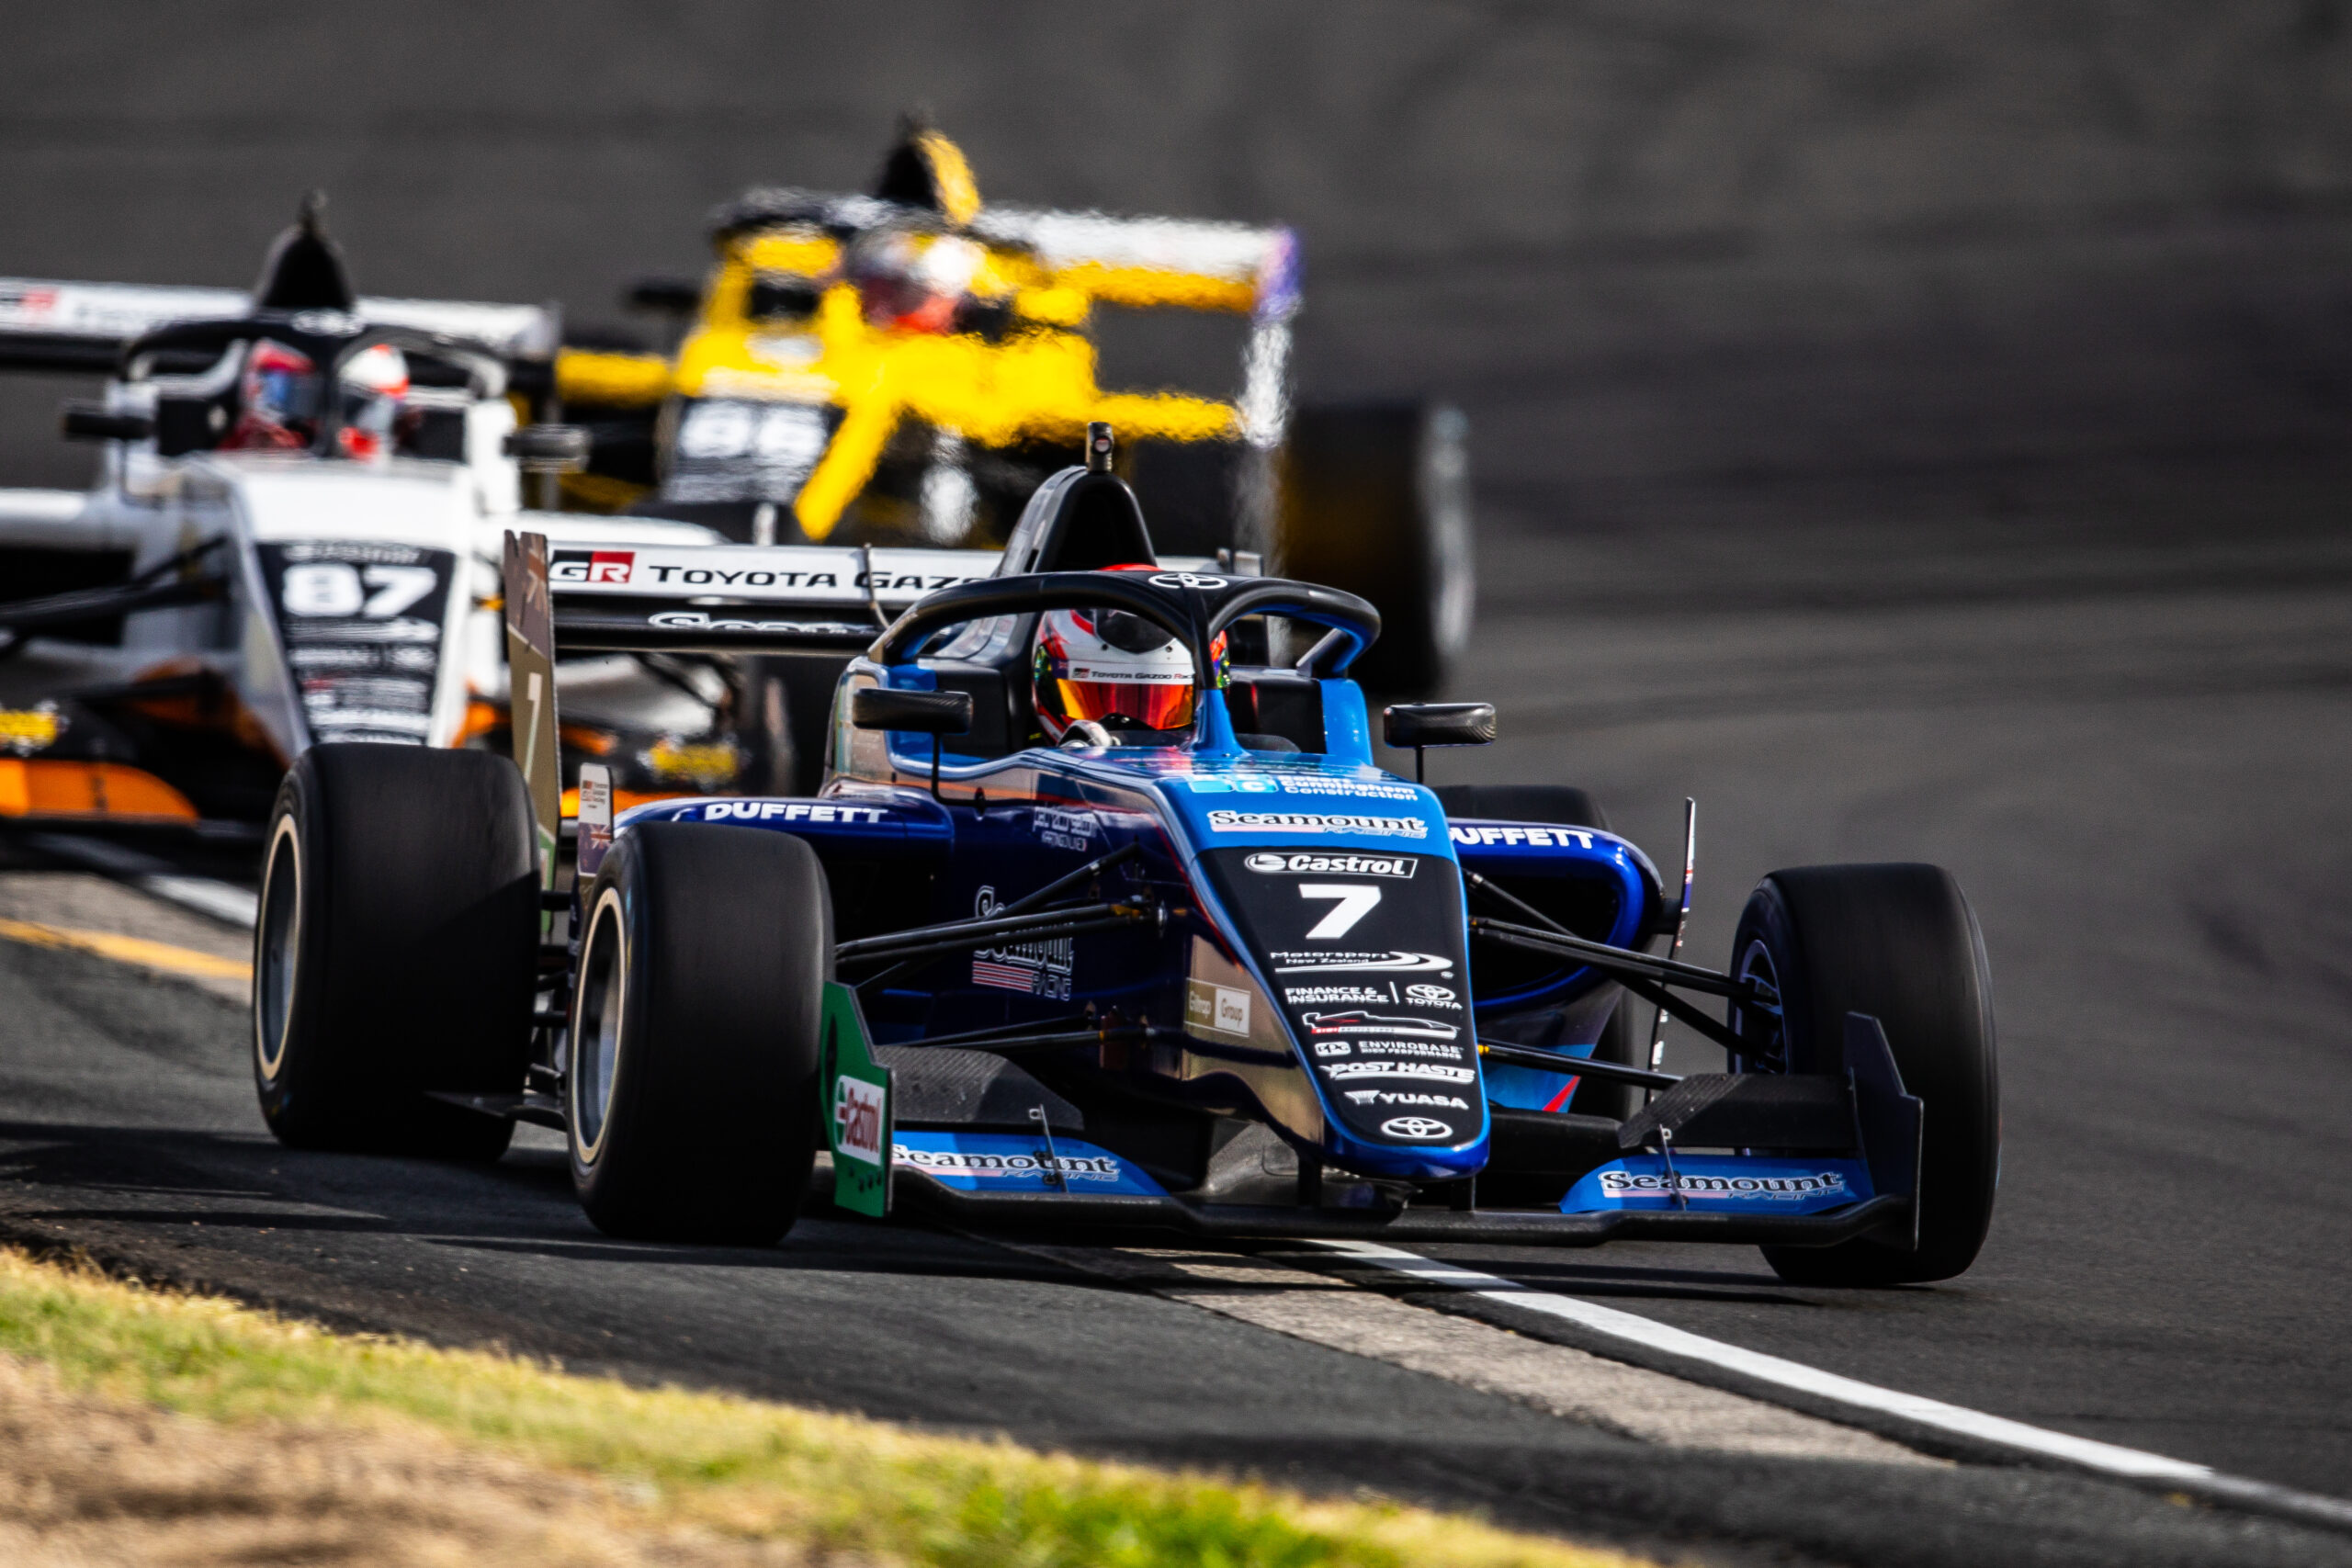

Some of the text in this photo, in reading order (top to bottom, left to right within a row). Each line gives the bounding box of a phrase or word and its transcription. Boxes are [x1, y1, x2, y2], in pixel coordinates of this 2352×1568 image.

[551, 558, 630, 582] GR
[649, 565, 981, 589] TOYOTA GAZ
[283, 562, 435, 617] 87
[1091, 671, 1132, 679] TOYOTA
[1284, 786, 1419, 801] Construction
[705, 802, 888, 823] DUFFETT
[1211, 810, 1427, 831] Seamount
[1288, 854, 1406, 875] Castrol
[1298, 884, 1382, 940] 7
[1285, 987, 1377, 996] FINANCE &
[1287, 995, 1389, 1005] INSURANCE
[1404, 998, 1463, 1010] TOYOTA
[1330, 1062, 1476, 1078] POST HASTE
[1378, 1092, 1470, 1111] YUASA
[1599, 1172, 1843, 1191] Seamount
